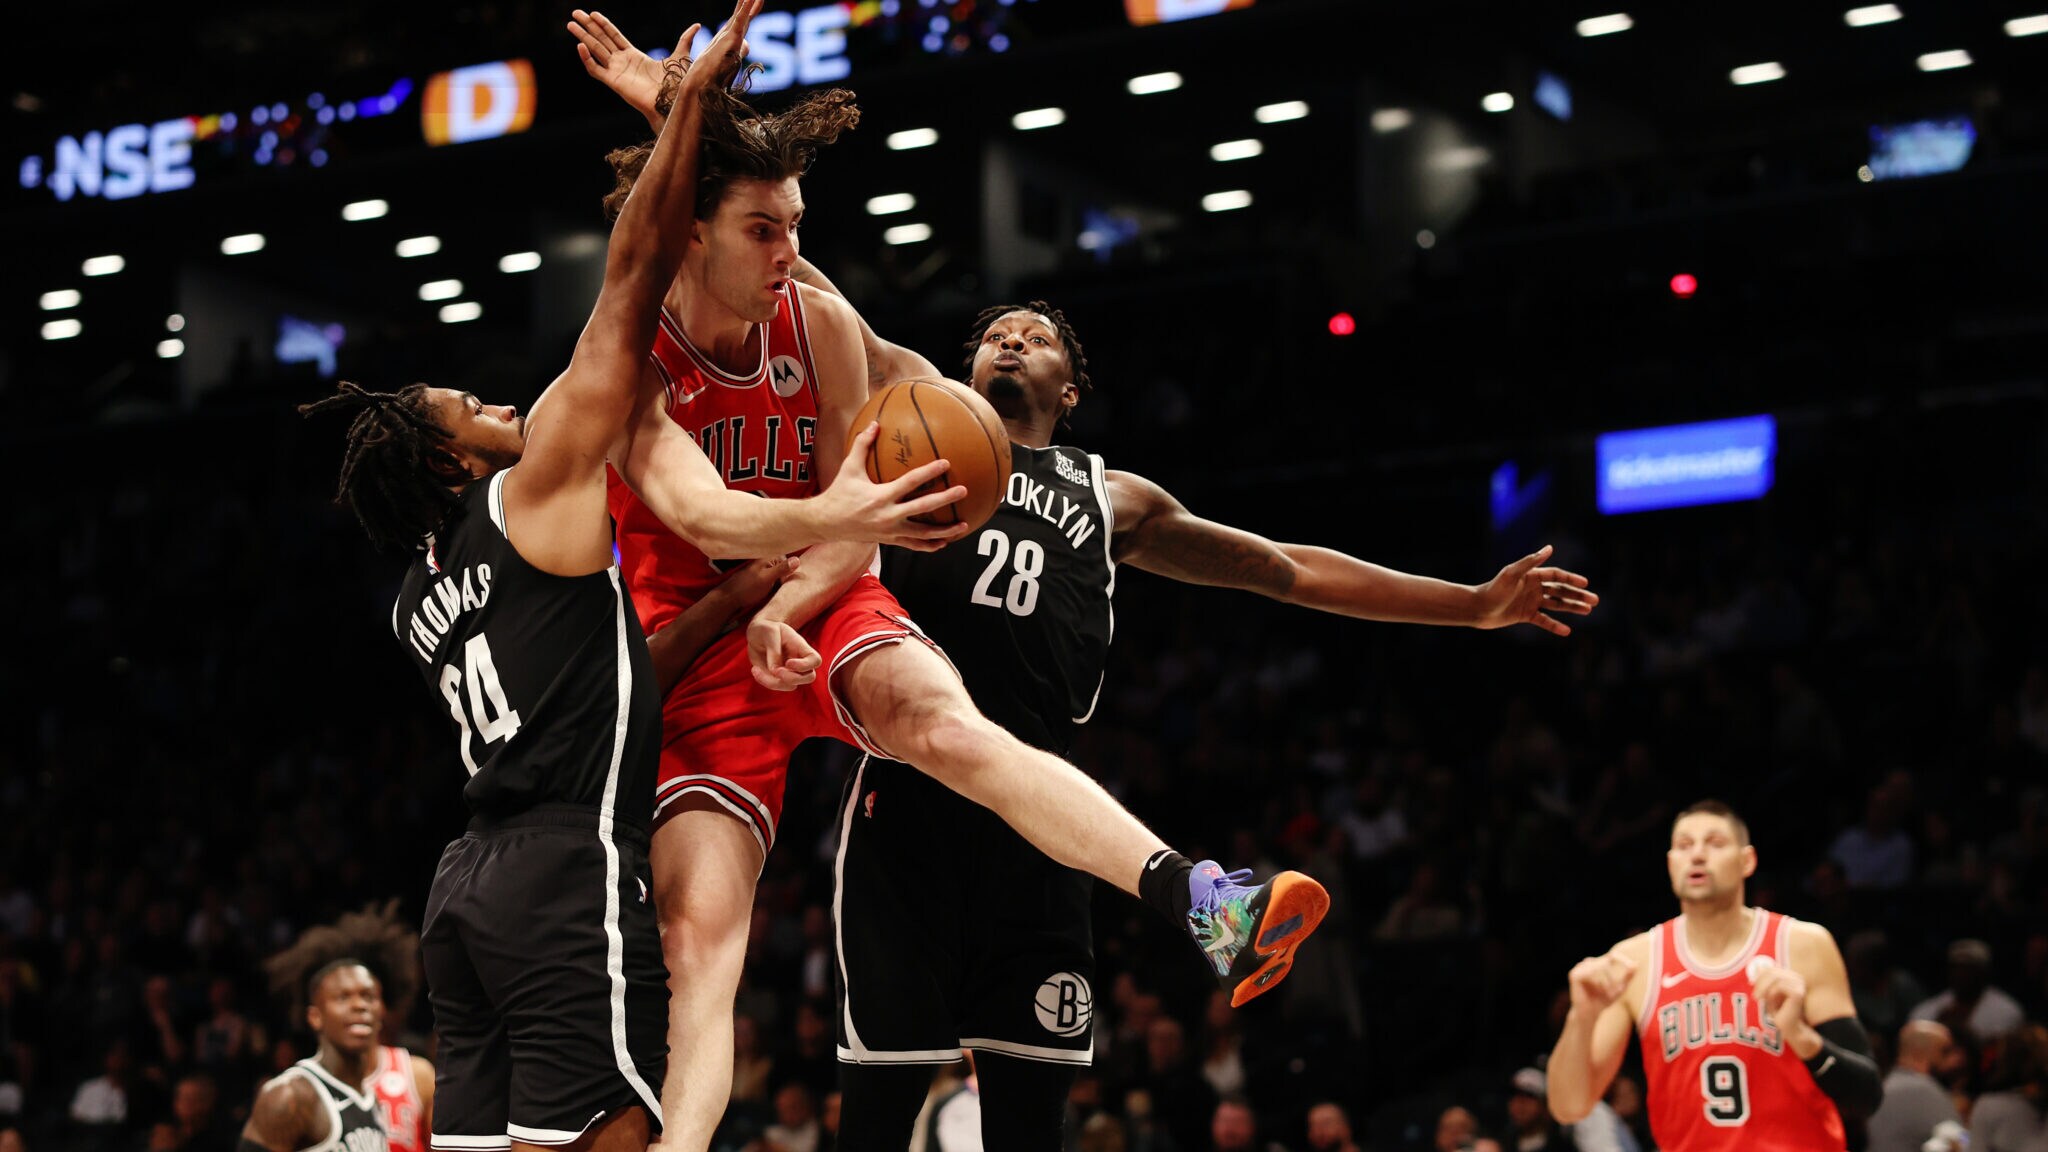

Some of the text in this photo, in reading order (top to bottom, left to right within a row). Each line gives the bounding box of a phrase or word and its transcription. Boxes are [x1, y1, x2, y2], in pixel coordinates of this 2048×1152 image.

[688, 415, 818, 483] ULLS
[1055, 450, 1075, 467] GET
[1055, 466, 1090, 487] GUIDE
[1056, 457, 1087, 479] YOUR
[971, 529, 1045, 617] 28
[410, 563, 491, 664] THOMAS
[1700, 1055, 1751, 1127] 9
